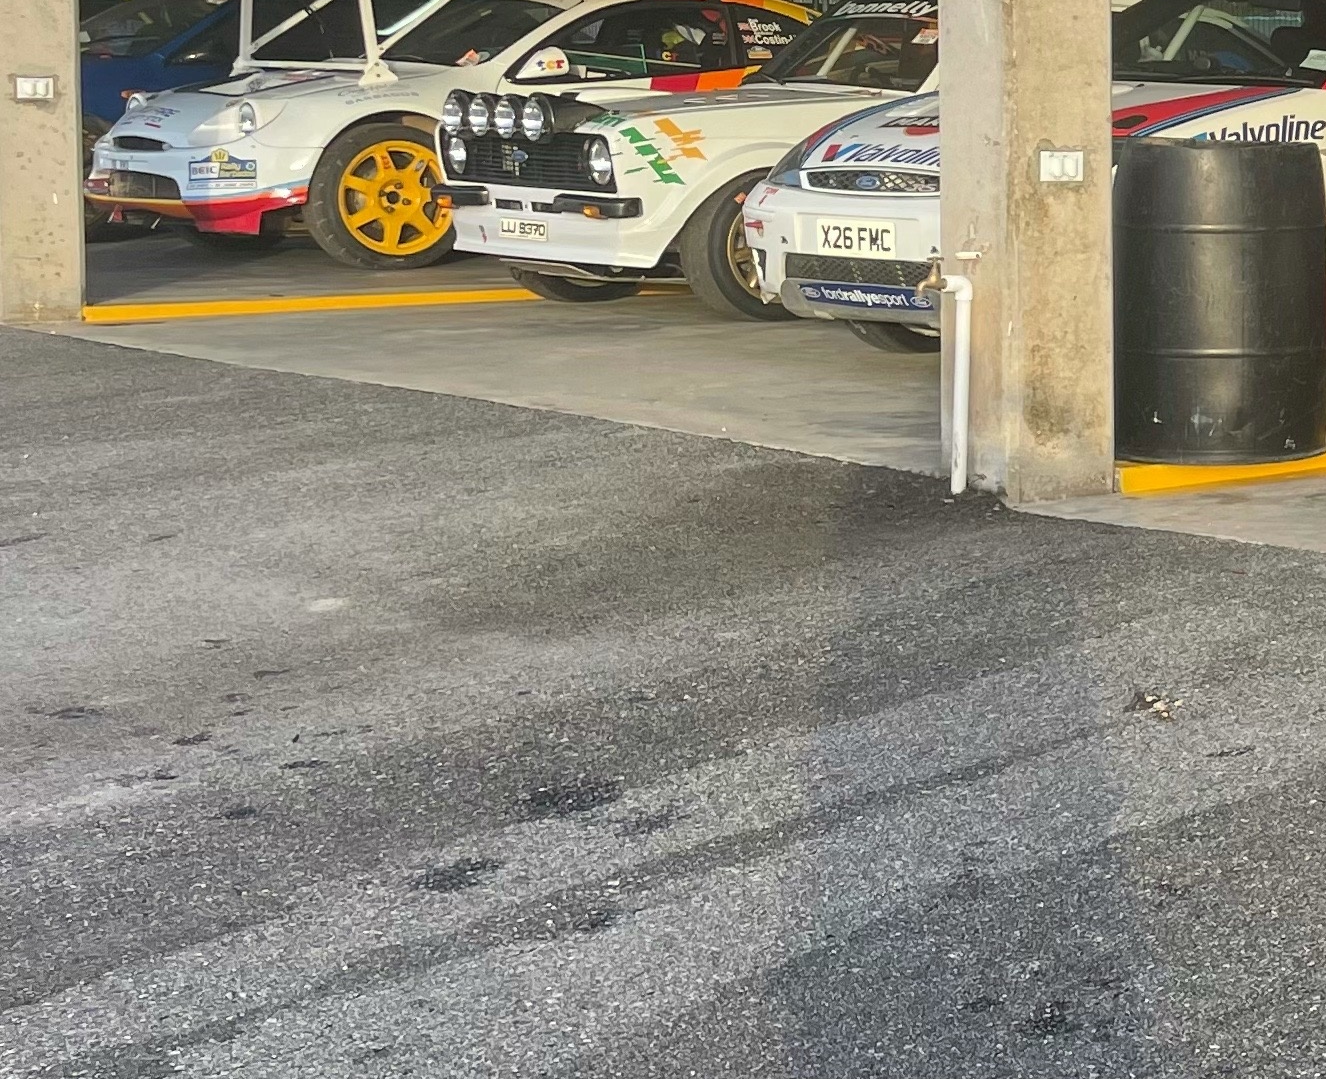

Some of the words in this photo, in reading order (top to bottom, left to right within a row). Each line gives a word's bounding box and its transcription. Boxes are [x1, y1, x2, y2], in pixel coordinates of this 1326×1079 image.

[832, 0, 939, 18] Donnelly
[821, 224, 853, 250] X26
[858, 227, 891, 252] FMC
[820, 286, 910, 307] fordrallyesport
